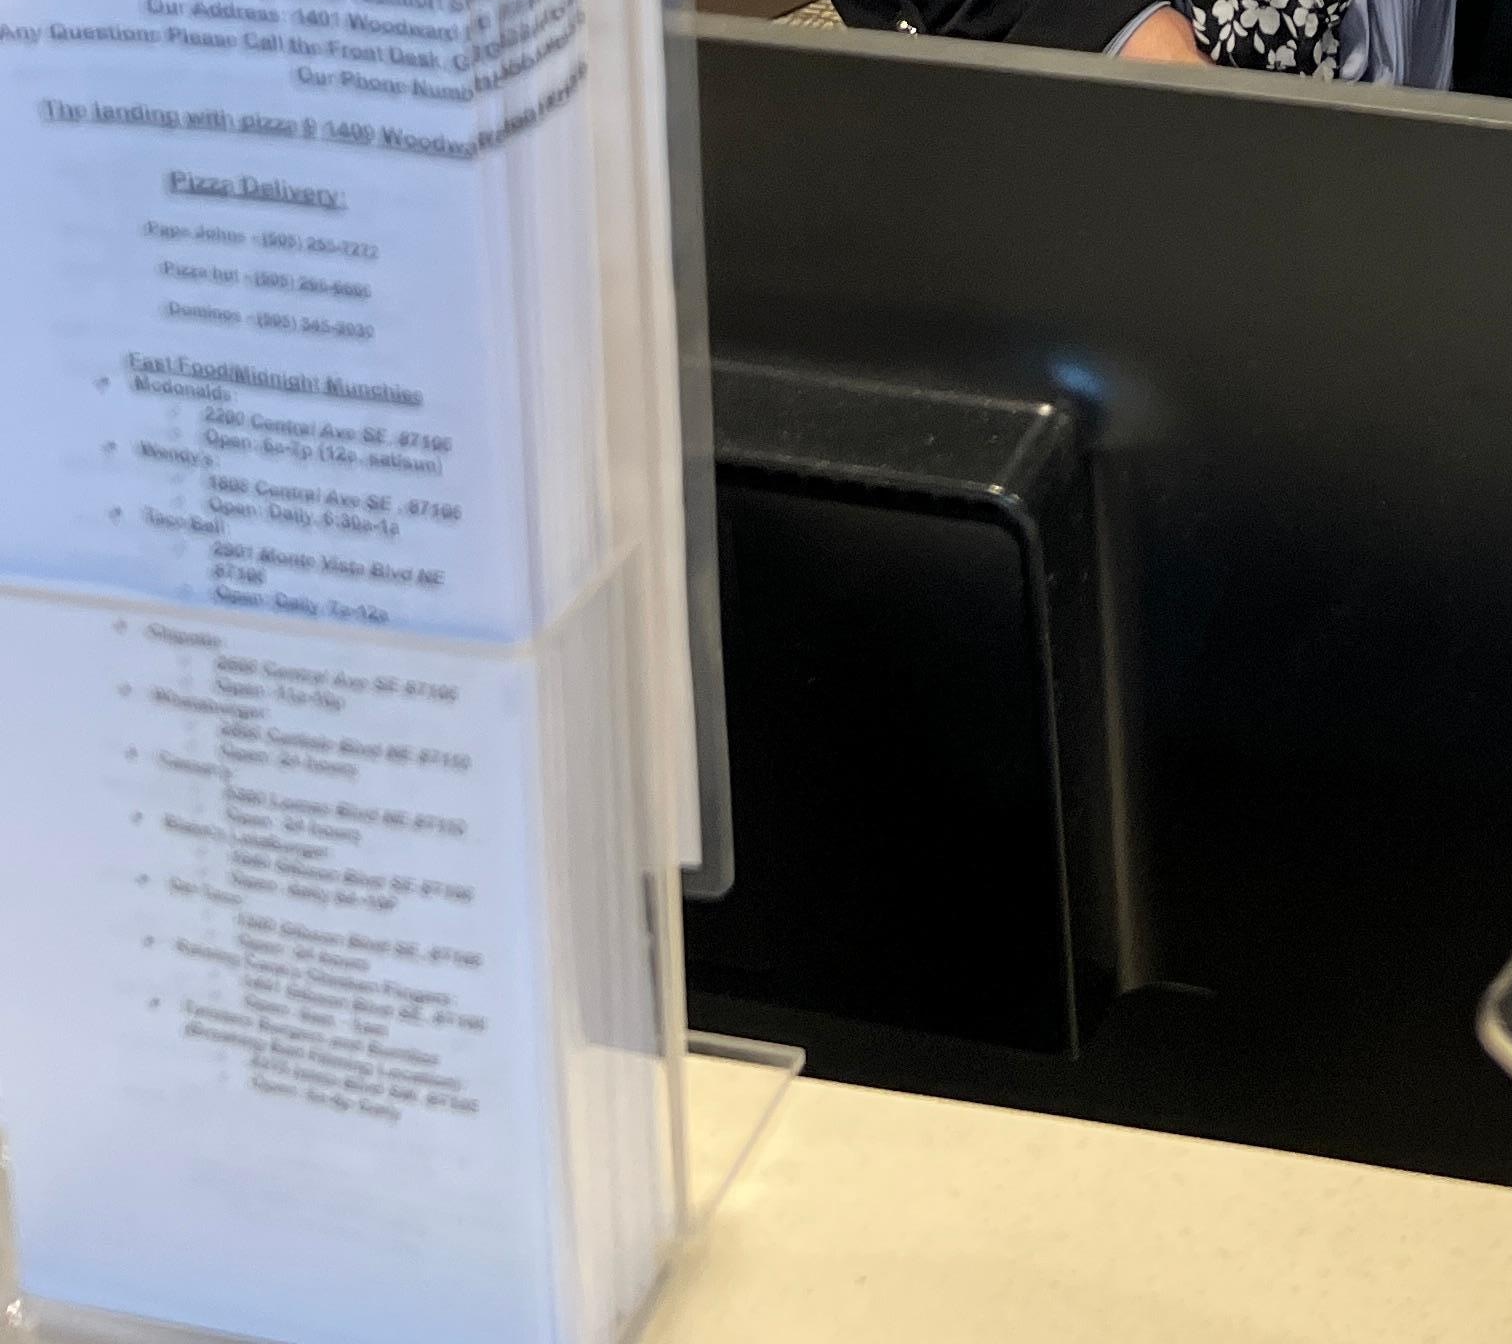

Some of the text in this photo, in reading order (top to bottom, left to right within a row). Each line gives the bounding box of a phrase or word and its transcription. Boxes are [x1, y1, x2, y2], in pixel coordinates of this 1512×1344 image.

[0, 23, 40, 46] Any
[167, 27, 239, 50] Please
[243, 30, 284, 54] Call
[288, 37, 322, 58] the
[327, 40, 385, 62] Front
[296, 65, 335, 86] Our
[43, 99, 87, 123] The
[94, 101, 178, 130] landing
[186, 108, 227, 130] with
[168, 169, 235, 198] Pizza
